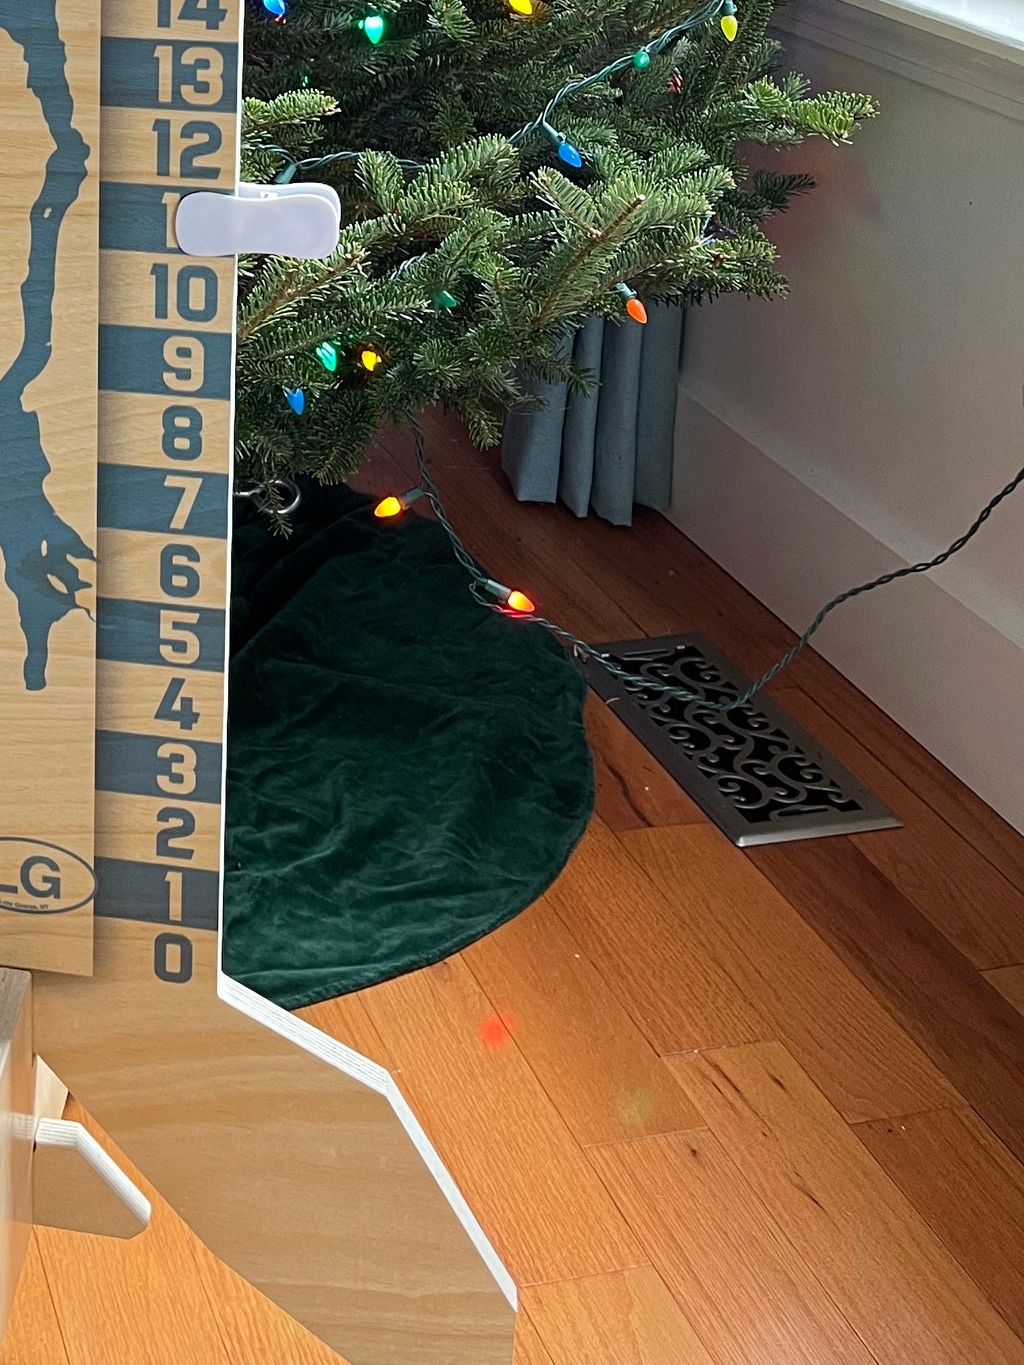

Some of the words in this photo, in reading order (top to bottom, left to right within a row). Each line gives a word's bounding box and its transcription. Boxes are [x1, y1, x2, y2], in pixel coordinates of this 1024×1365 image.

[153, 46, 223, 105] 13
[152, 119, 222, 180] 12
[150, 263, 218, 322] 10
[163, 336, 205, 391] 9
[162, 405, 203, 461] 8
[164, 476, 203, 529] 7
[160, 544, 200, 598] 6
[160, 611, 199, 664] 5
[155, 678, 200, 729] 4
[156, 743, 197, 794] 3
[156, 807, 195, 860] 2
[164, 871, 182, 921] 1
[154, 933, 192, 983] 0
